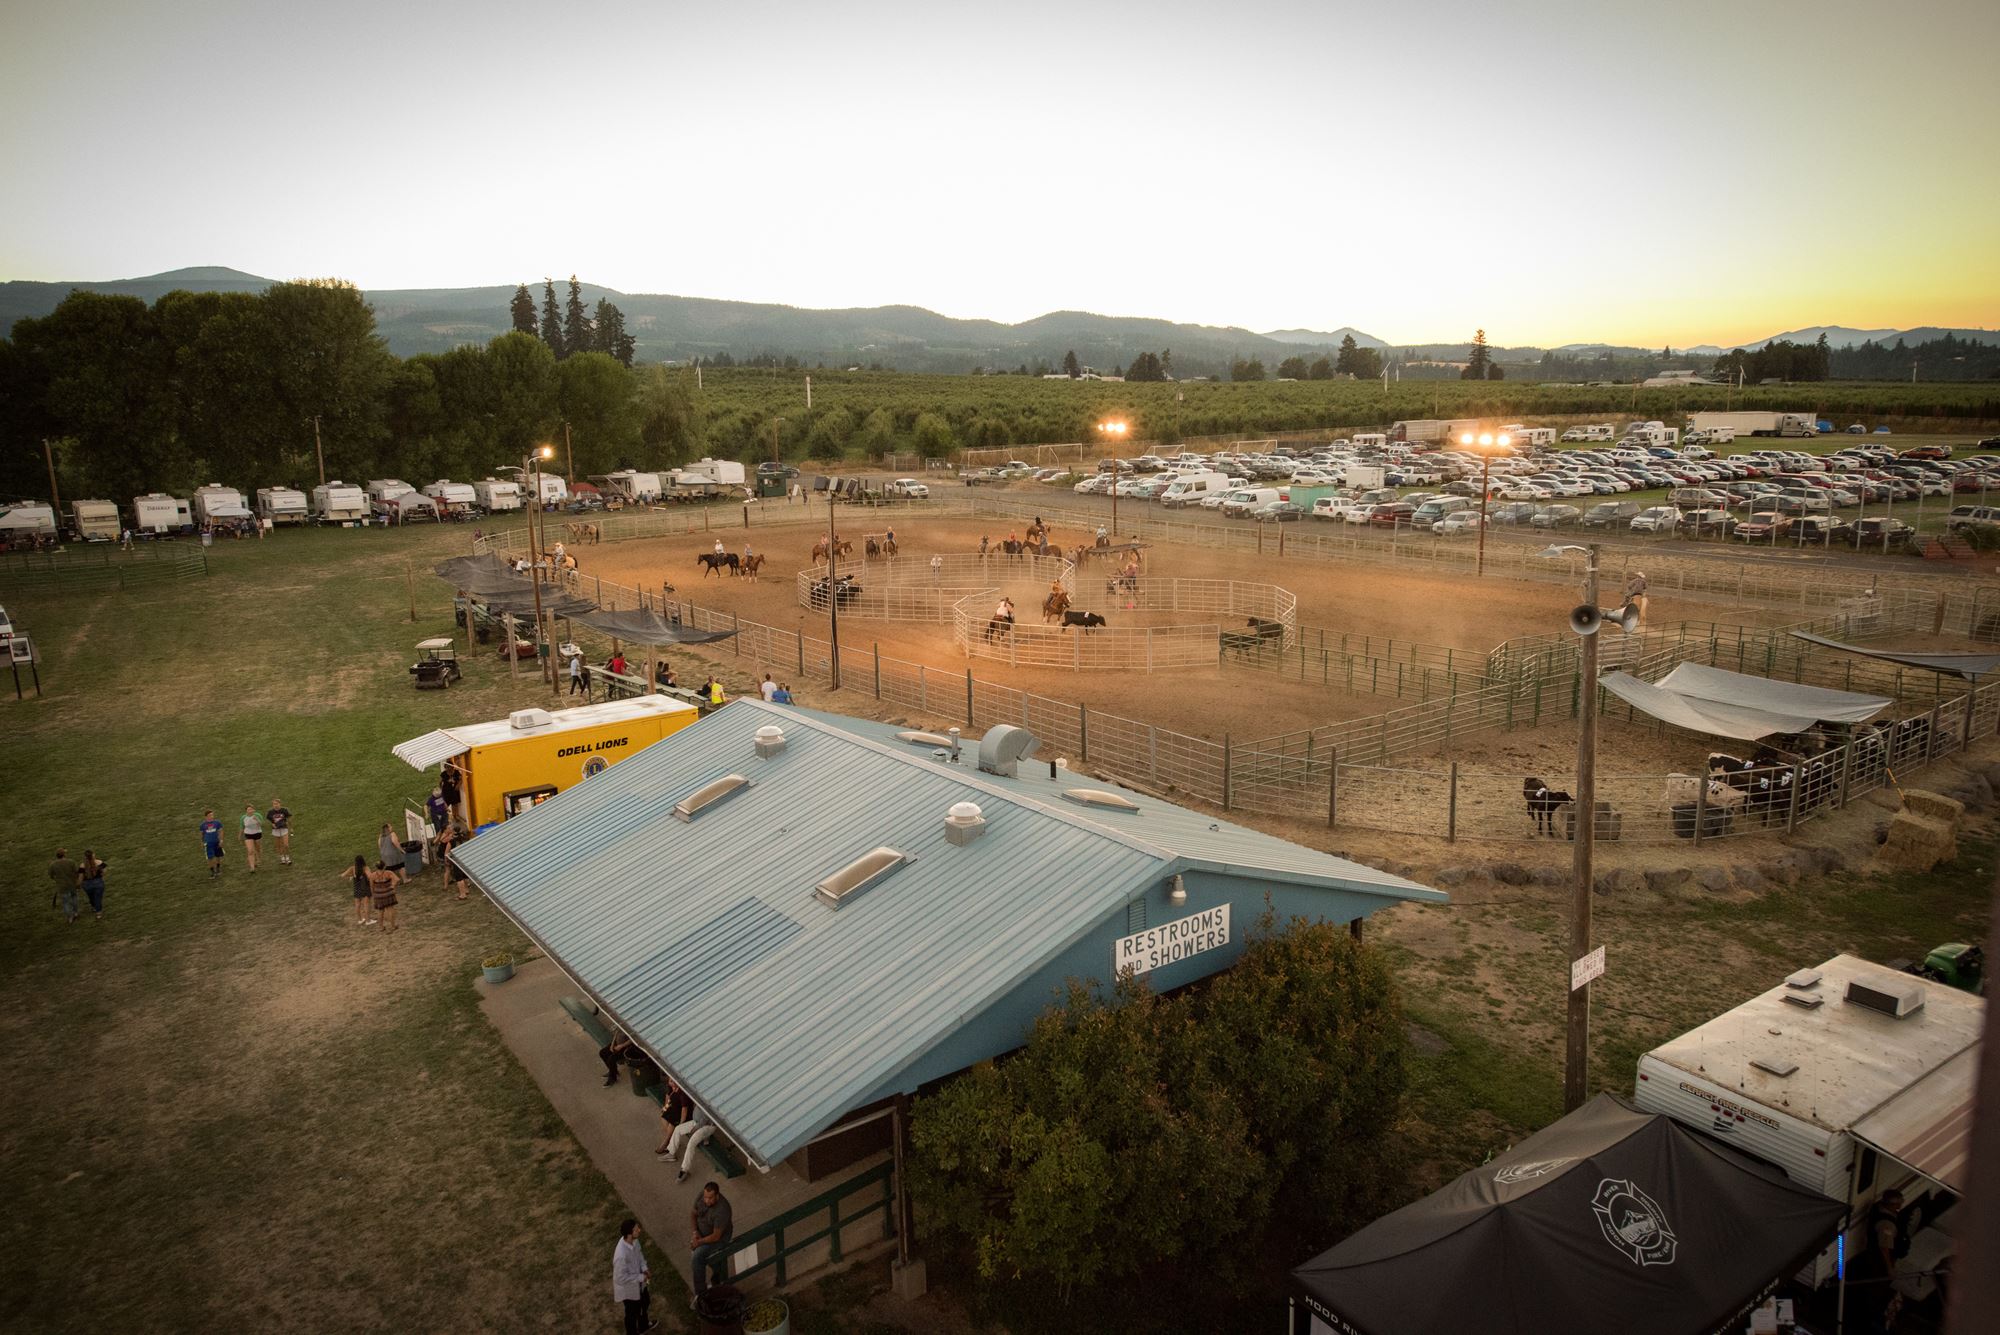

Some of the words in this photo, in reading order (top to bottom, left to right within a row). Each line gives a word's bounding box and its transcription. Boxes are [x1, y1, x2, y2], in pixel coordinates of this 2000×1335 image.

[557, 743, 593, 758] ODELL
[595, 737, 629, 751] LIONS
[1123, 909, 1223, 957] RESTROOMS
[1150, 927, 1226, 969] SHOWERS
[1680, 1082, 1717, 1103] SEARCH
[1718, 1098, 1740, 1112] AND
[1740, 1107, 1780, 1130] RESCUE
[1603, 1184, 1620, 1199] RIVER
[1605, 1223, 1625, 1247] HOOD
[1304, 1295, 1338, 1324] HOOD
